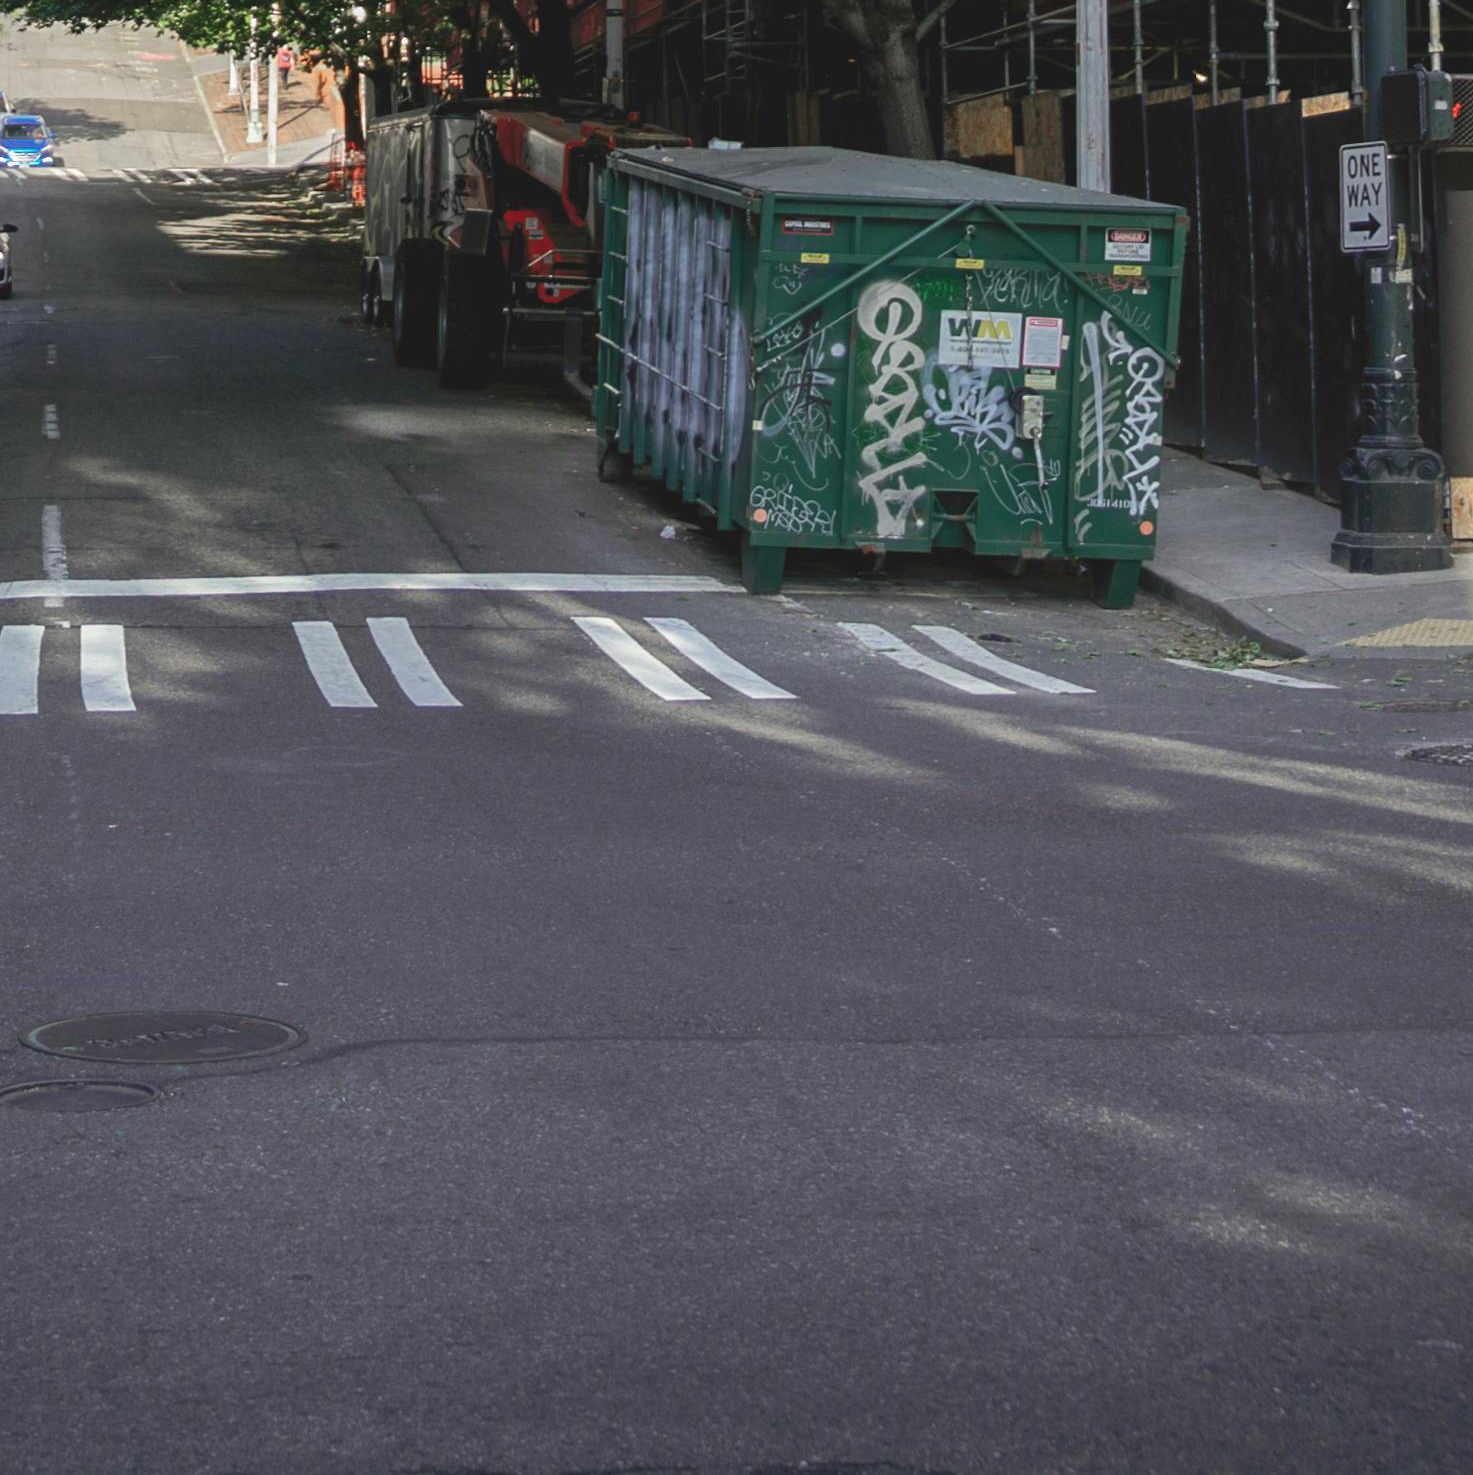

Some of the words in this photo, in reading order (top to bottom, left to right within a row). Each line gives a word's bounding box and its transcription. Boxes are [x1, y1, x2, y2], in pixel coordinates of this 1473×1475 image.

[1347, 153, 1382, 178] ONE
[1347, 183, 1383, 207] WAY
[1114, 232, 1144, 241] DANGER
[948, 317, 1012, 340] WM
